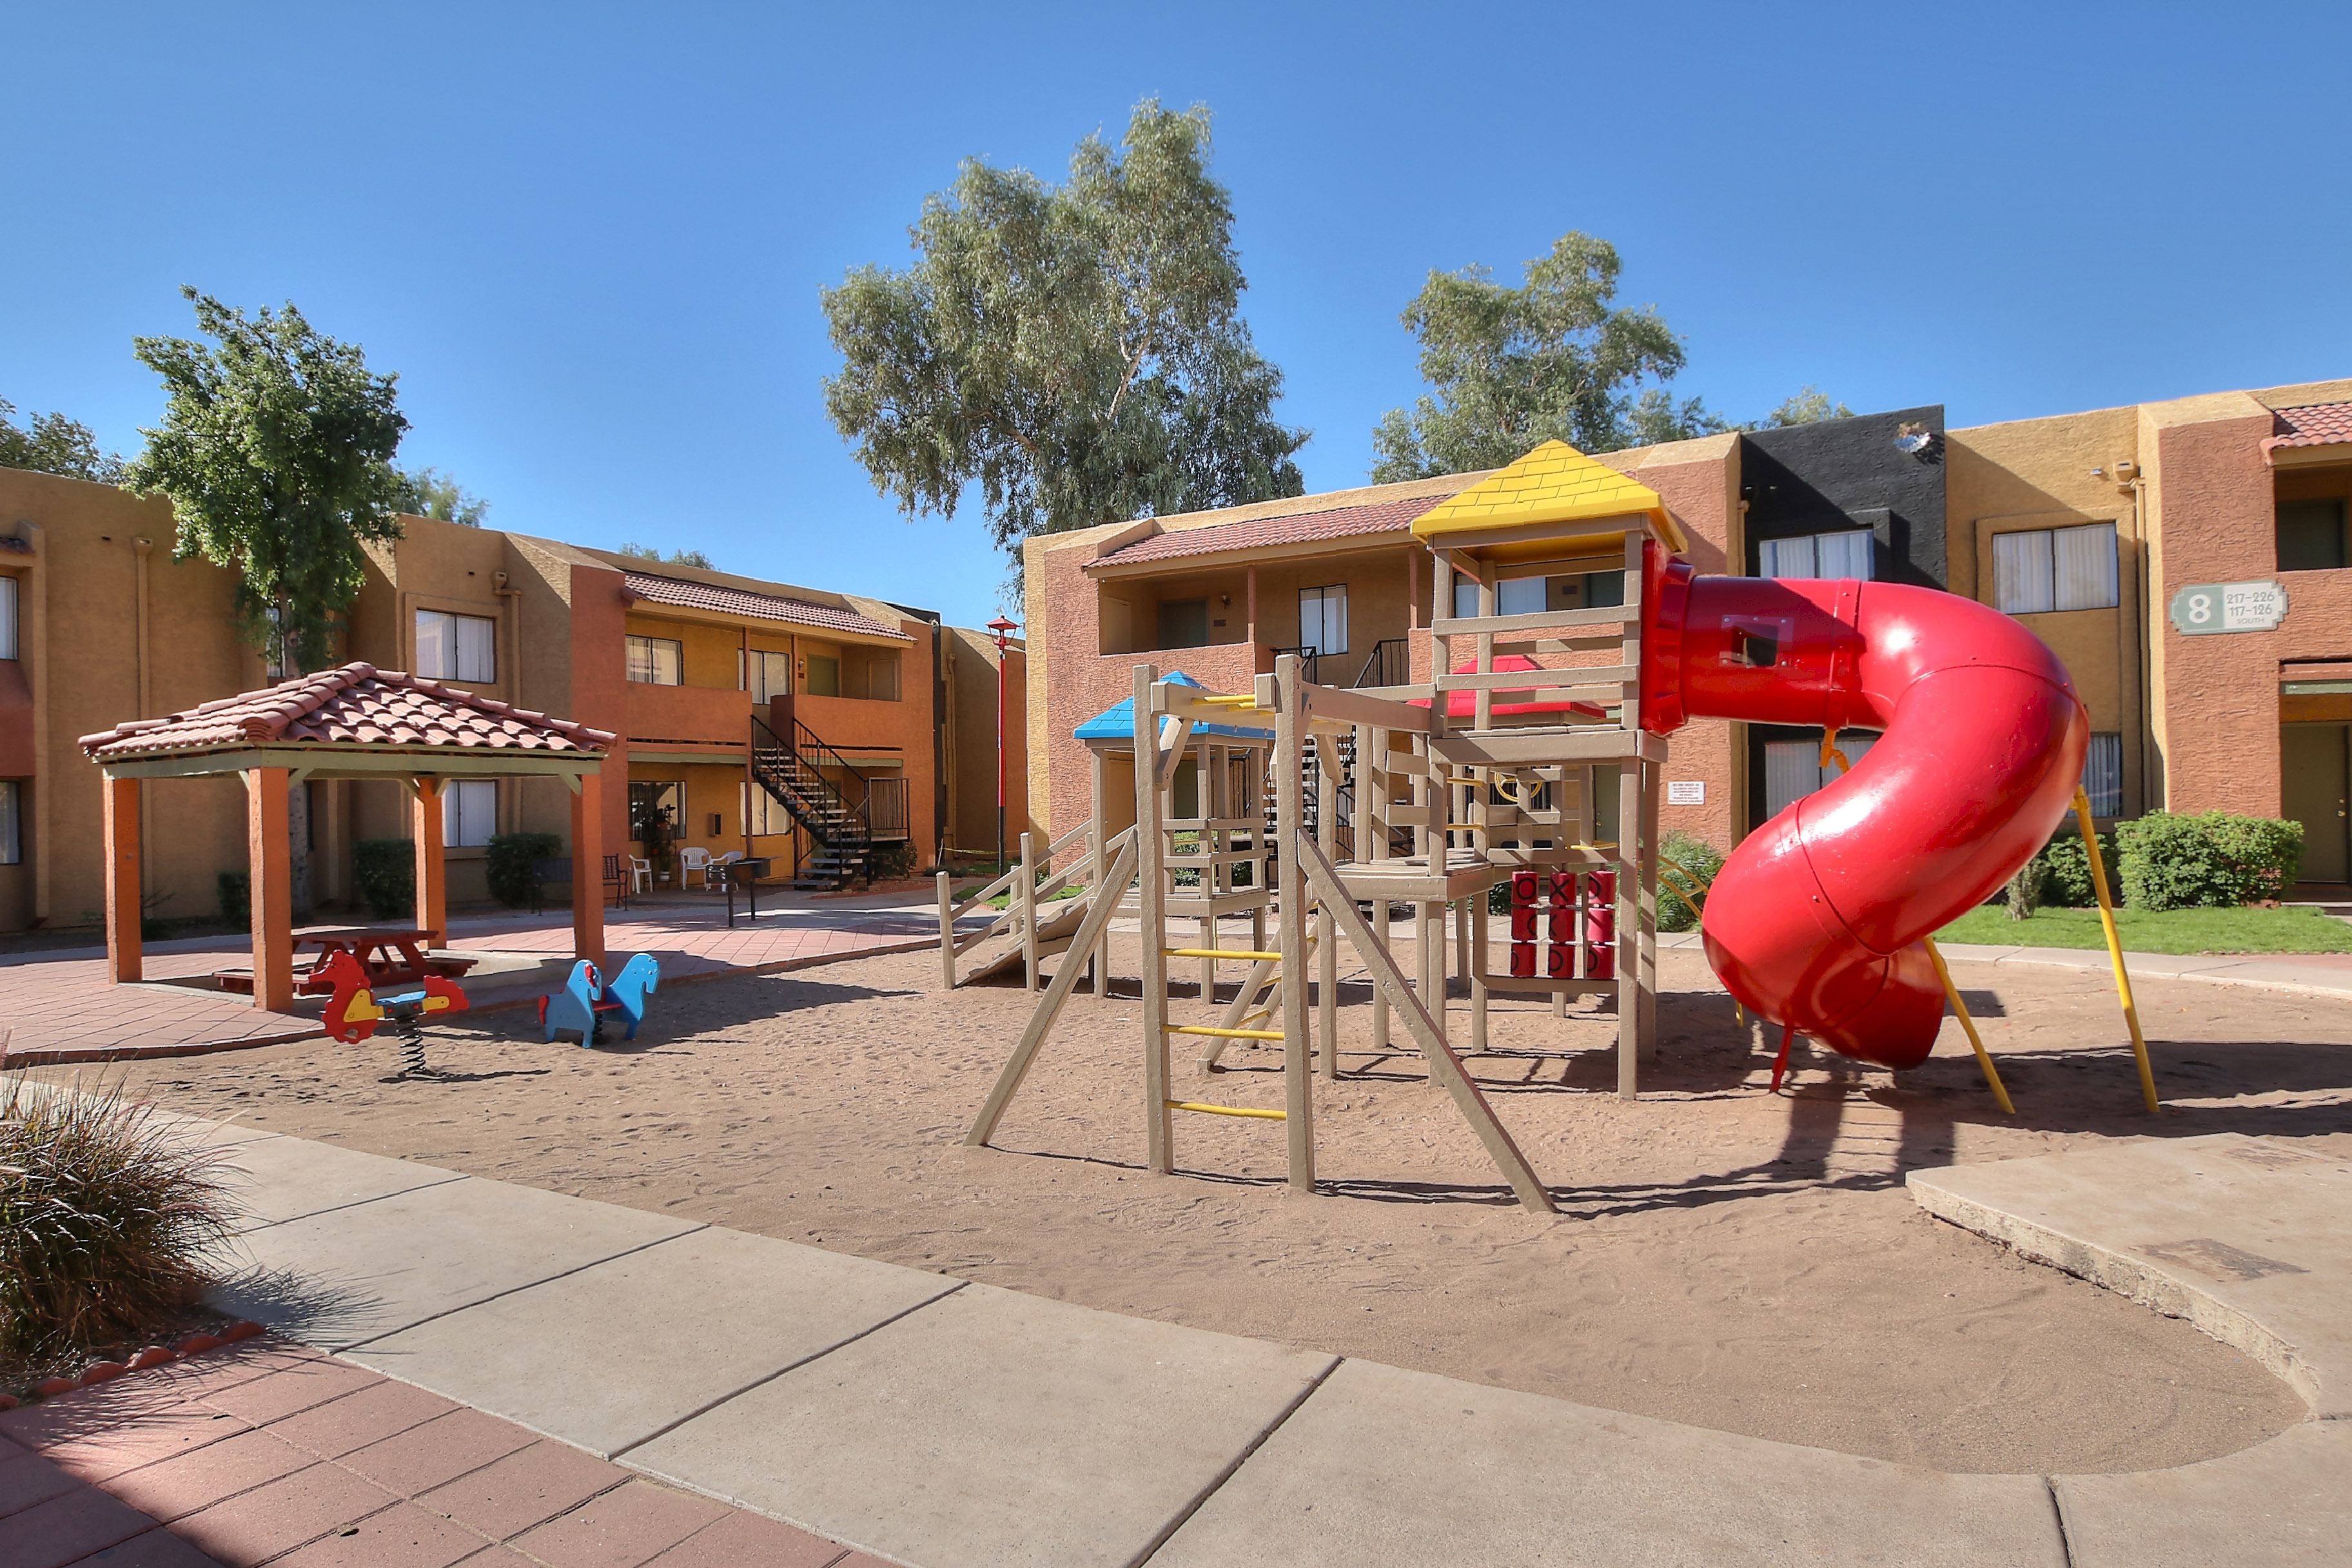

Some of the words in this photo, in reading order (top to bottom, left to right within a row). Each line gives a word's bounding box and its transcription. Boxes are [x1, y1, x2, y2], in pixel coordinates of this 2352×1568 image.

[2226, 592, 2275, 604] 217-226
[2189, 594, 2211, 623] 8
[2230, 604, 2272, 616] 117-126
